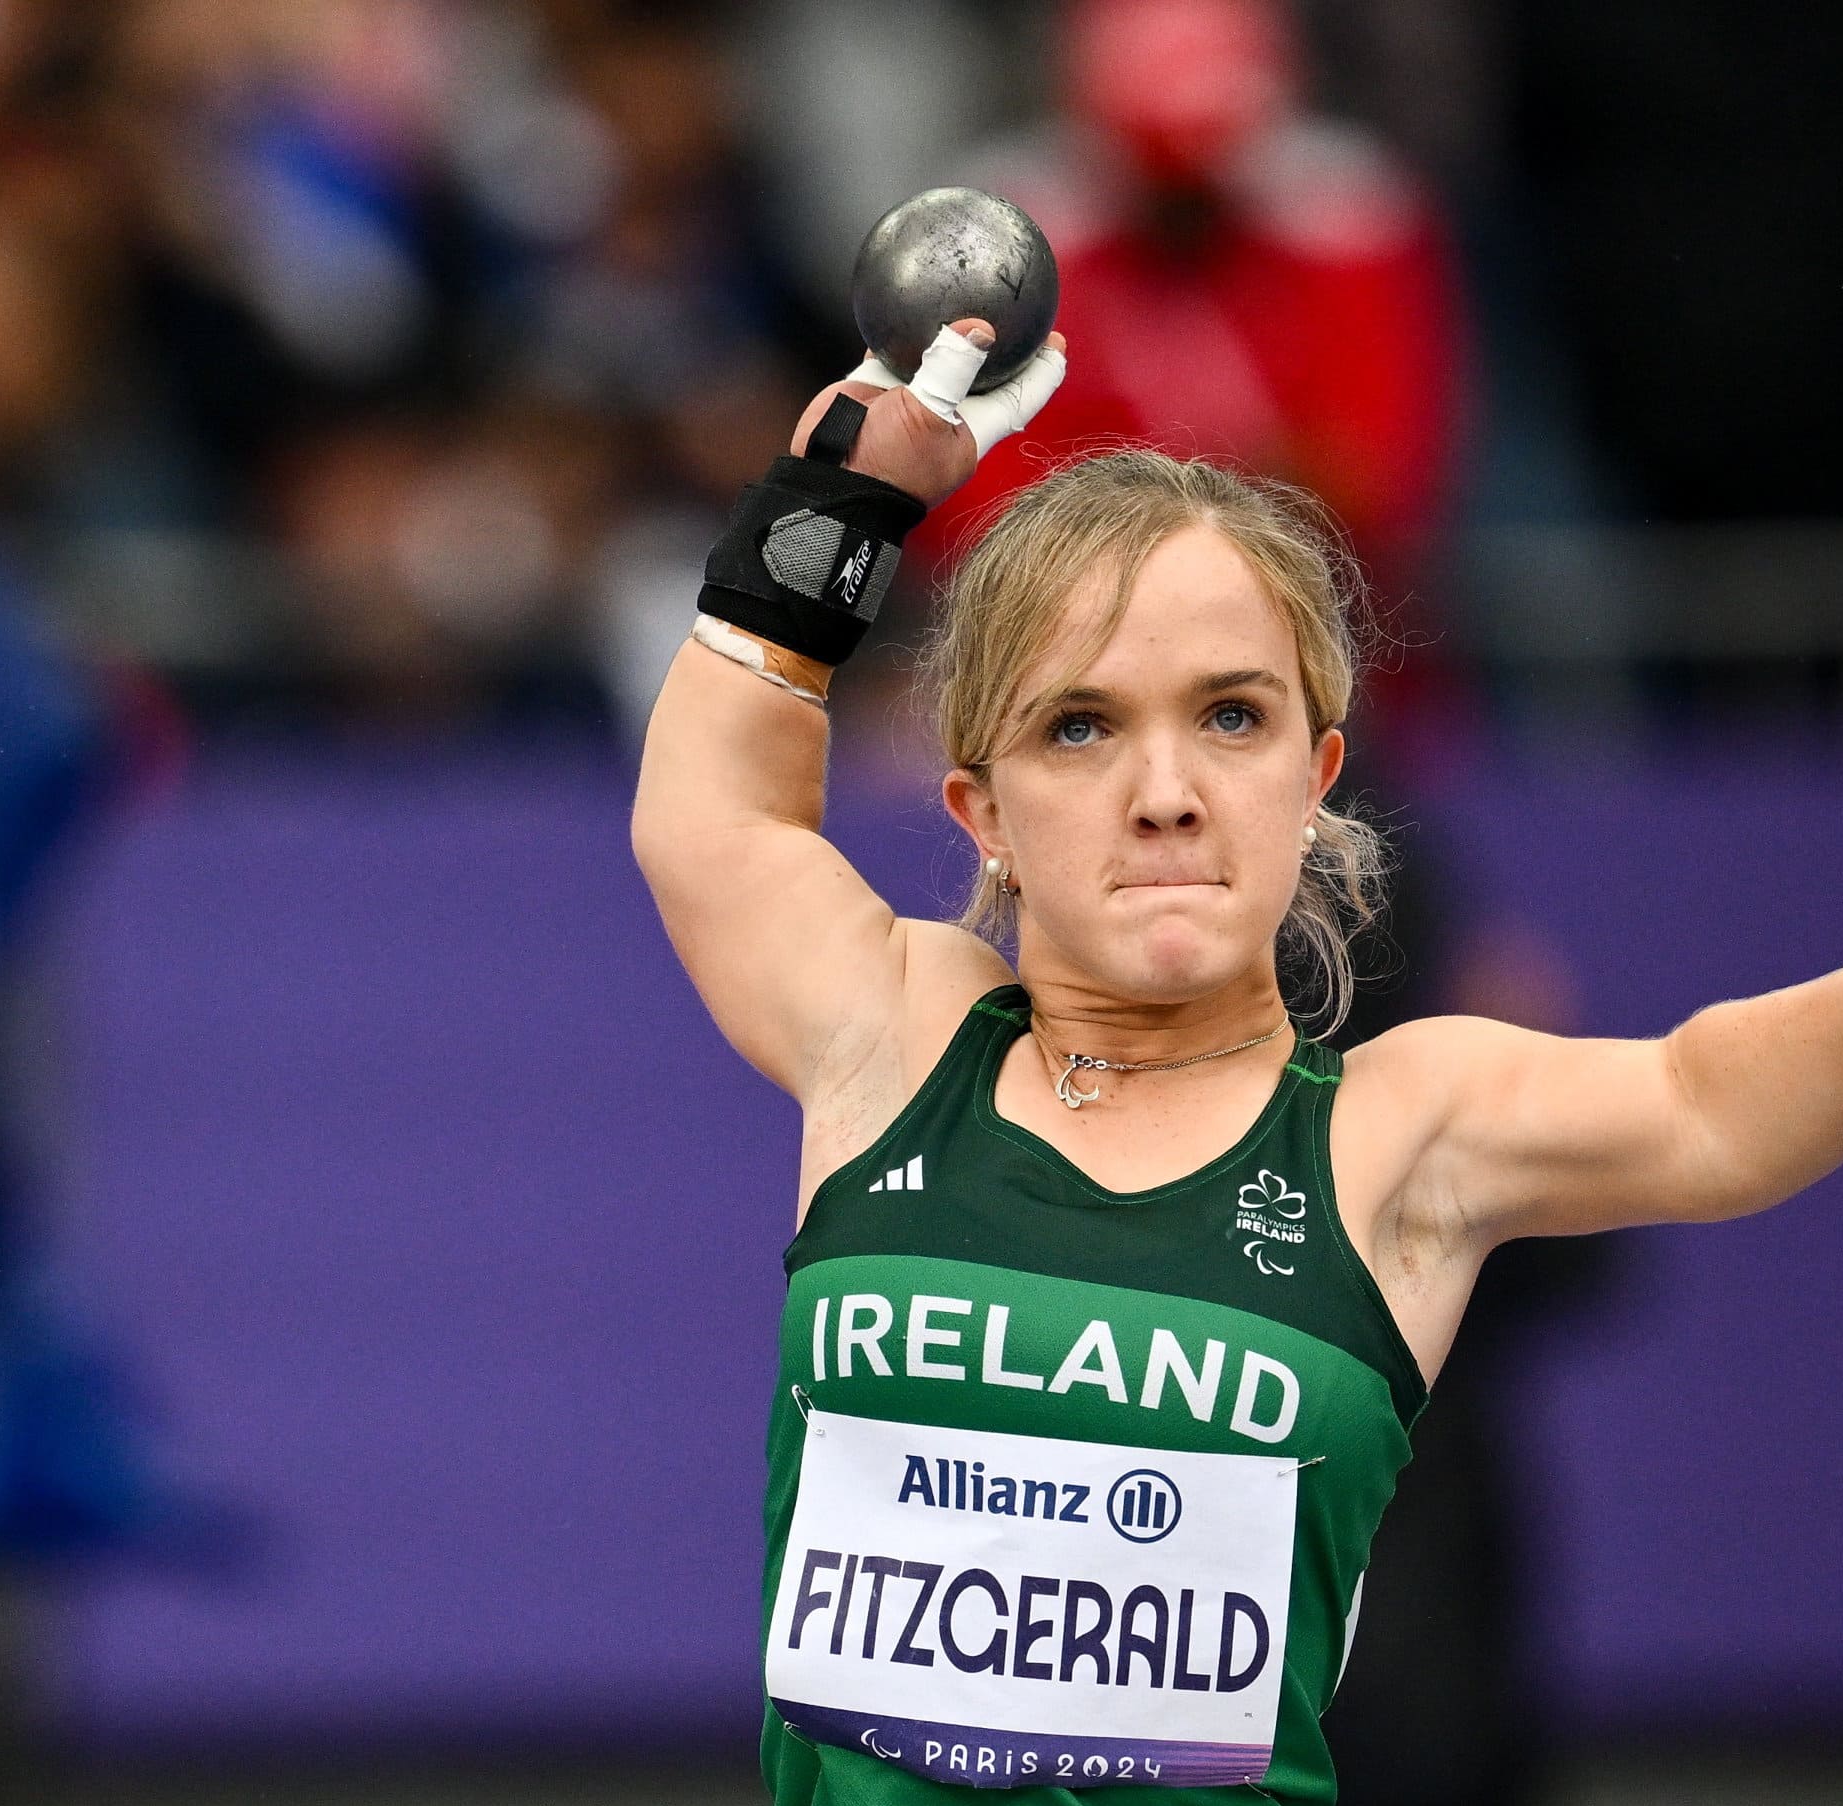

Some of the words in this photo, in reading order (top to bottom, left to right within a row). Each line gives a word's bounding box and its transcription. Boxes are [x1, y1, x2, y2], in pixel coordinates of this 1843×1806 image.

[1235, 1217, 1306, 1244] IRELAND
[1236, 1210, 1306, 1233] PARALYMPICS
[812, 1293, 1300, 1444] IRELAND
[897, 1454, 1091, 1524] Allianz
[788, 1548, 1270, 1693] FITZGERALD
[1056, 1753, 1162, 1779] 2024
